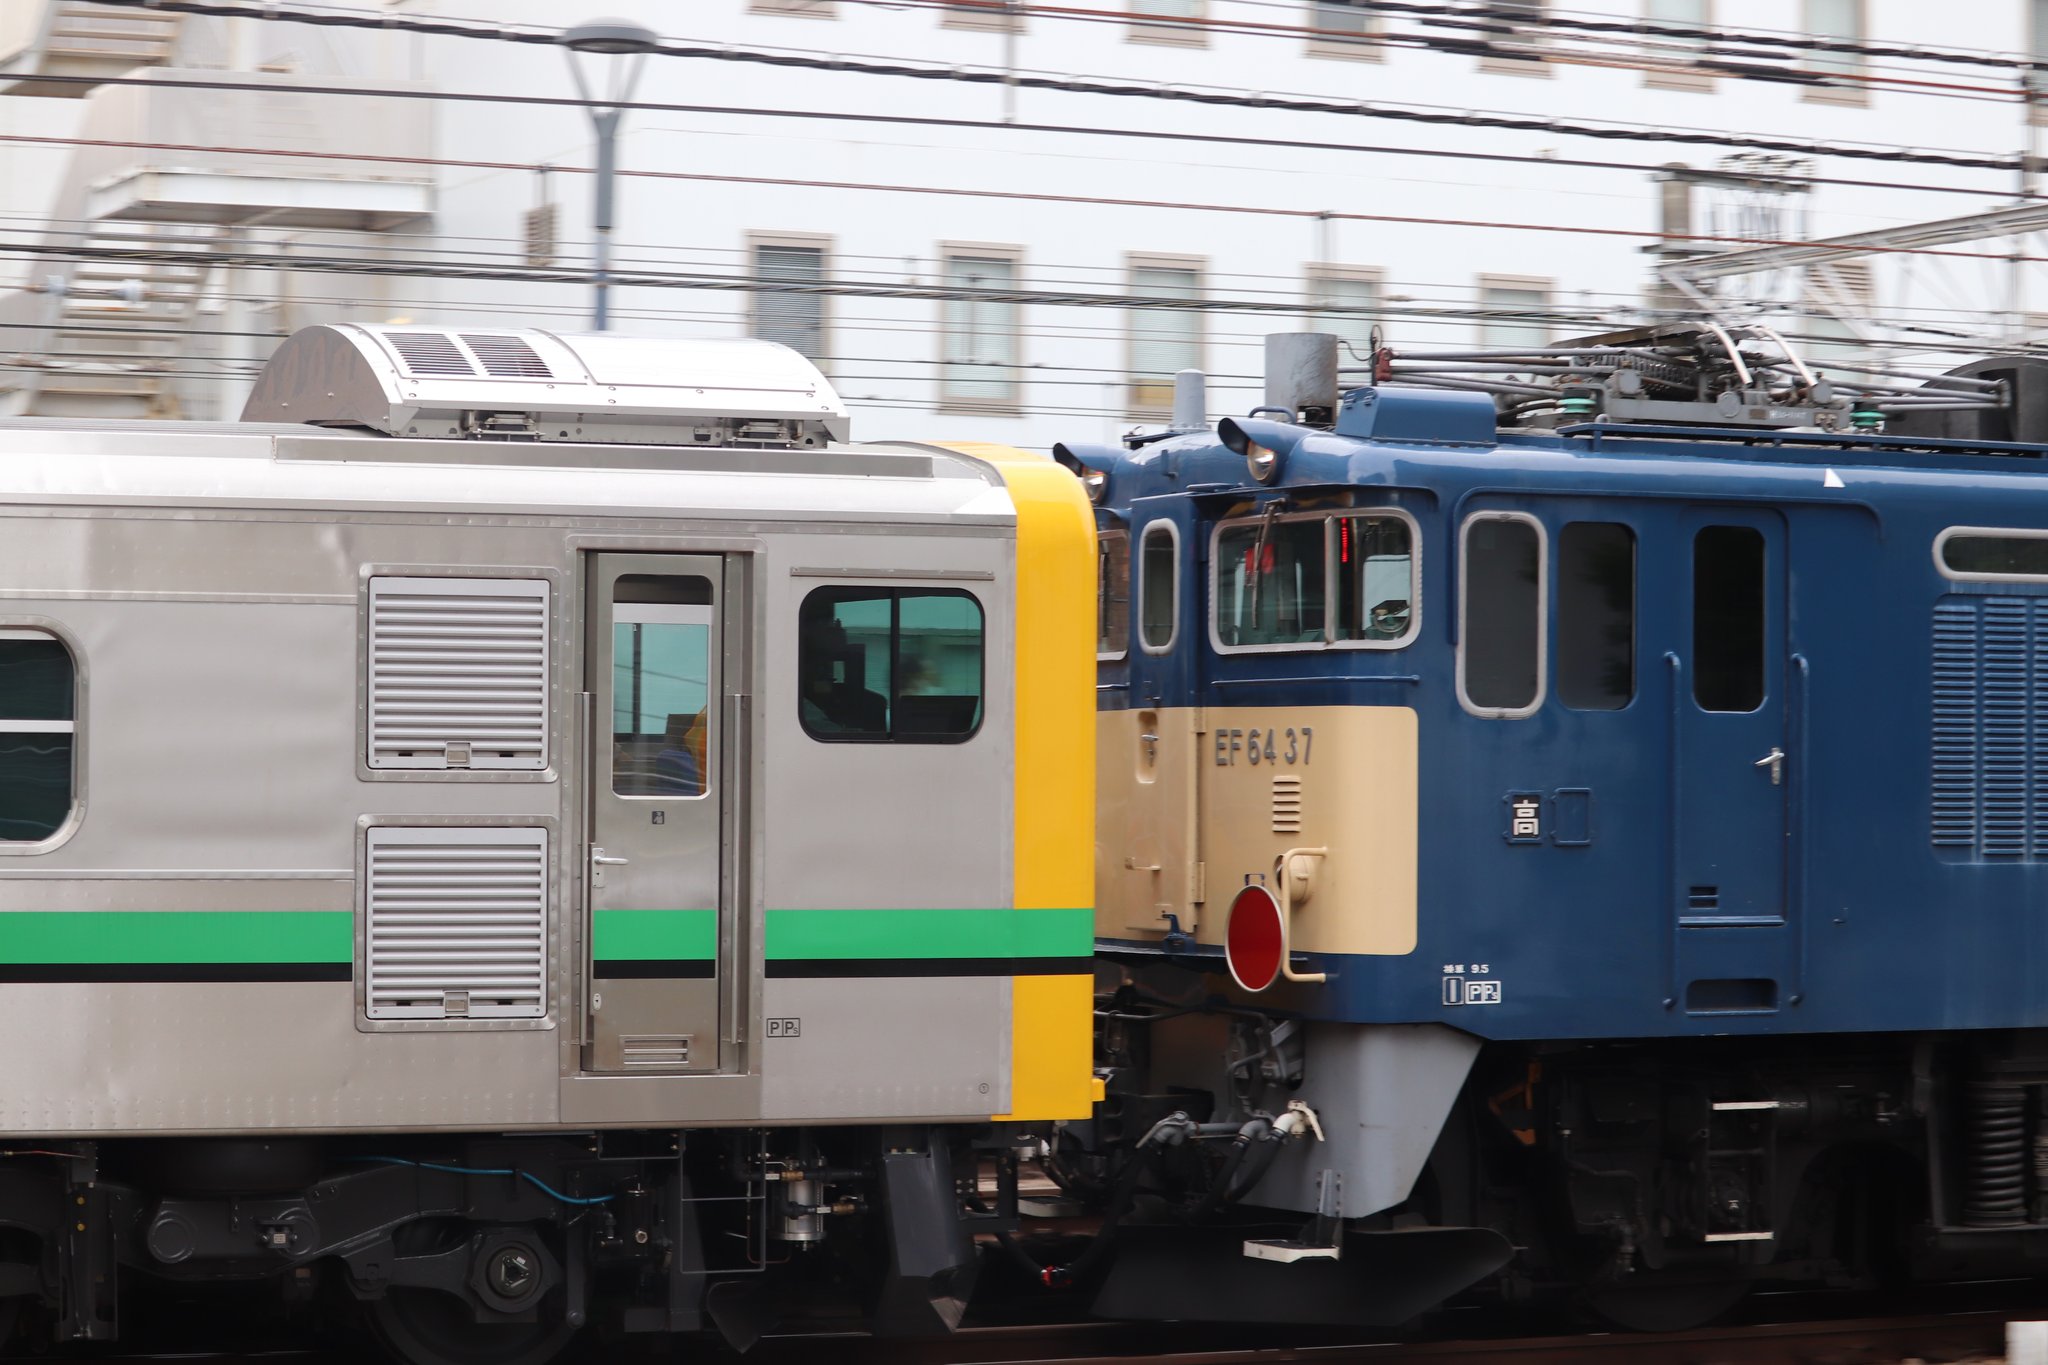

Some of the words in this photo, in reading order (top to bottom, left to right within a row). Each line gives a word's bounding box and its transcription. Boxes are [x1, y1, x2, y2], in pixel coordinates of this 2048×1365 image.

[1215, 728, 1277, 766] EF64
[1284, 727, 1313, 766] 37
[1512, 799, 1539, 836] 高
